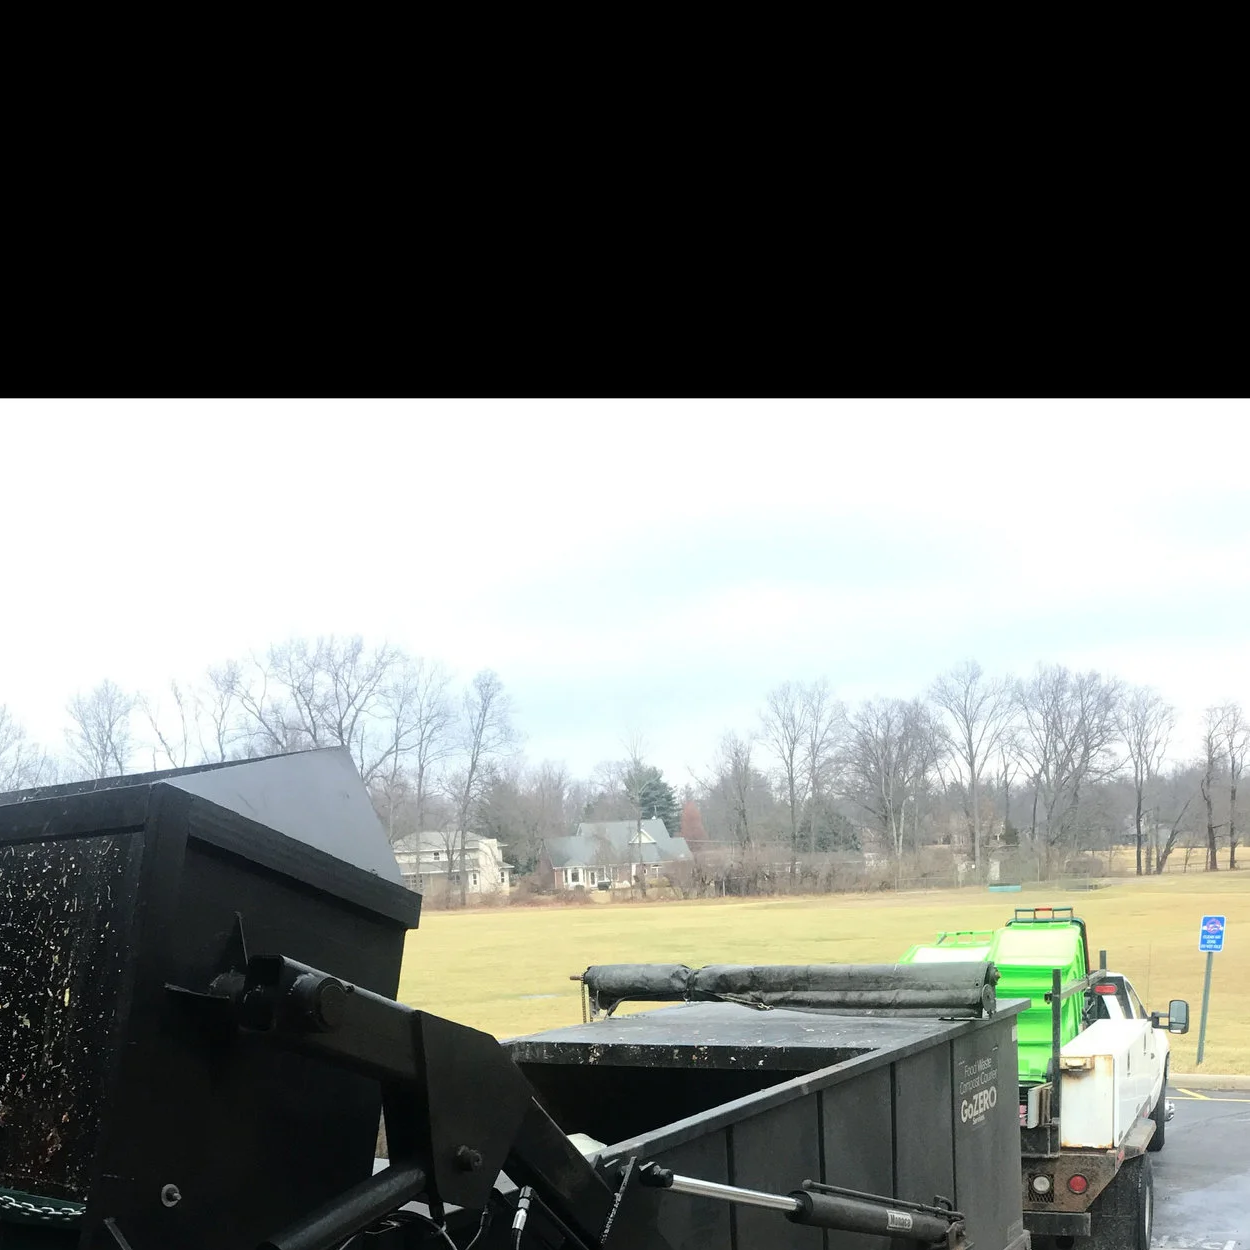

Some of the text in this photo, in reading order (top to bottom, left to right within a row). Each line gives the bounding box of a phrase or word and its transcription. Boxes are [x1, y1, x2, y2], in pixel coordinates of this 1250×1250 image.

[959, 1069, 997, 1094] Compost Courier
[964, 1062, 978, 1077] Food
[961, 1086, 997, 1123] GoZERO
